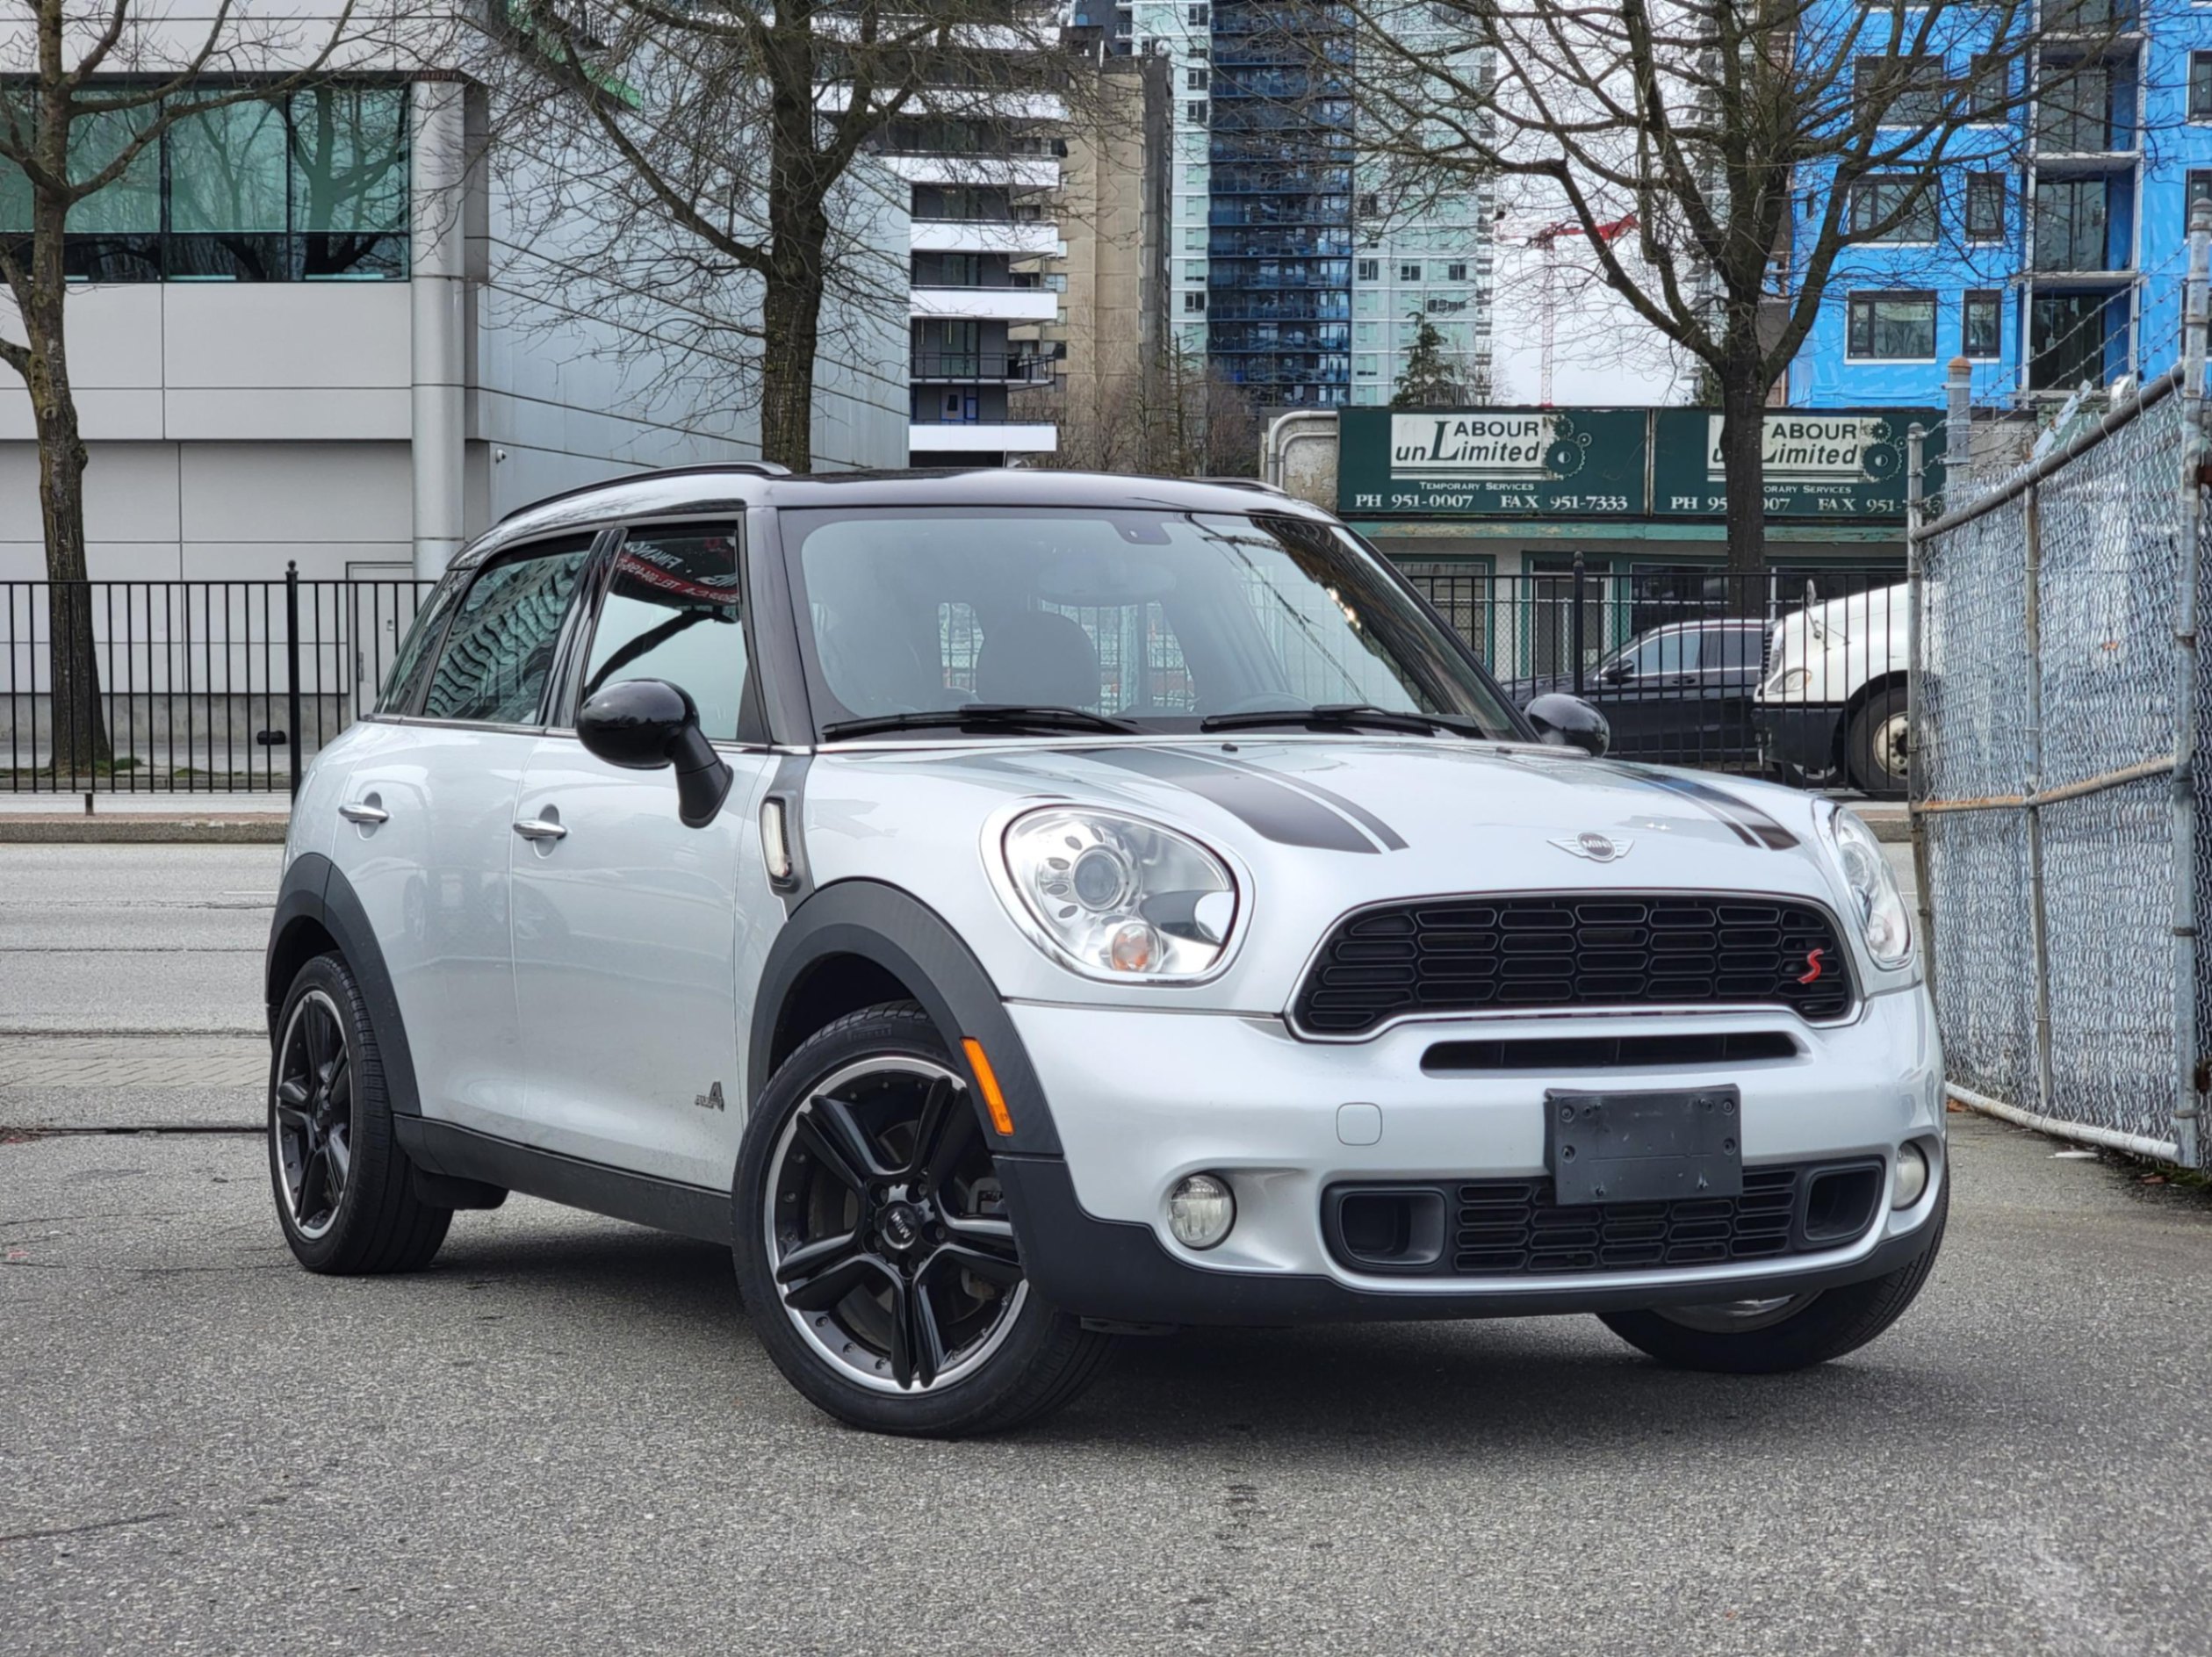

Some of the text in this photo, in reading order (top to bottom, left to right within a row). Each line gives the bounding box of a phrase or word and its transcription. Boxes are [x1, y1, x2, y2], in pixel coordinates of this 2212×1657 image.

[1762, 422, 1857, 440] ABOUR
[1394, 421, 1540, 462] unLimited
[1711, 443, 1858, 465] uimited
[1419, 482, 1535, 492] TEMPORARY SERVICES
[1762, 485, 1852, 493] ORARY SERVICES
[1355, 493, 1628, 511] PH 951-0007 FAX 951-7333
[1670, 496, 1699, 509] PH
[1817, 498, 1857, 511] FAX
[1581, 839, 1611, 849] MINI
[1797, 947, 1825, 984] S
[890, 1211, 912, 1240] MINI
